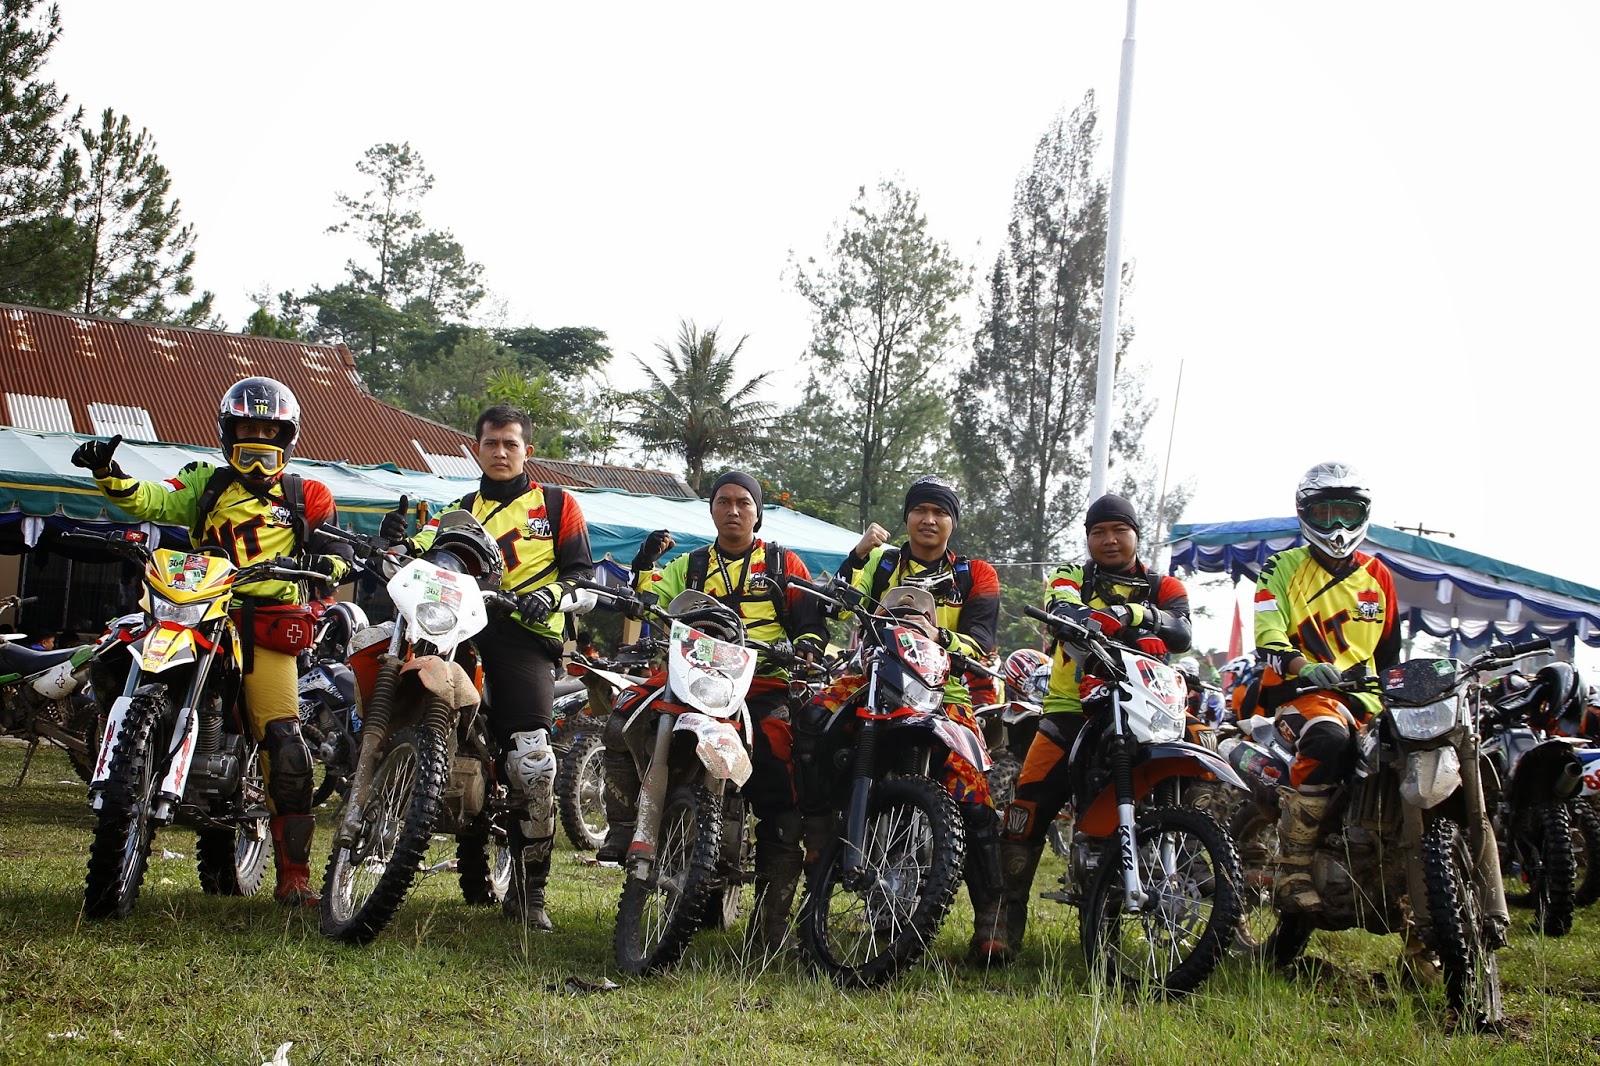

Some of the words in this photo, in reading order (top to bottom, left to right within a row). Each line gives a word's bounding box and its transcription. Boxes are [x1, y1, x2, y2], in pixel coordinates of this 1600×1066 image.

[168, 559, 184, 568] 364
[426, 586, 440, 597] 362
[1120, 824, 1135, 871] KYB
